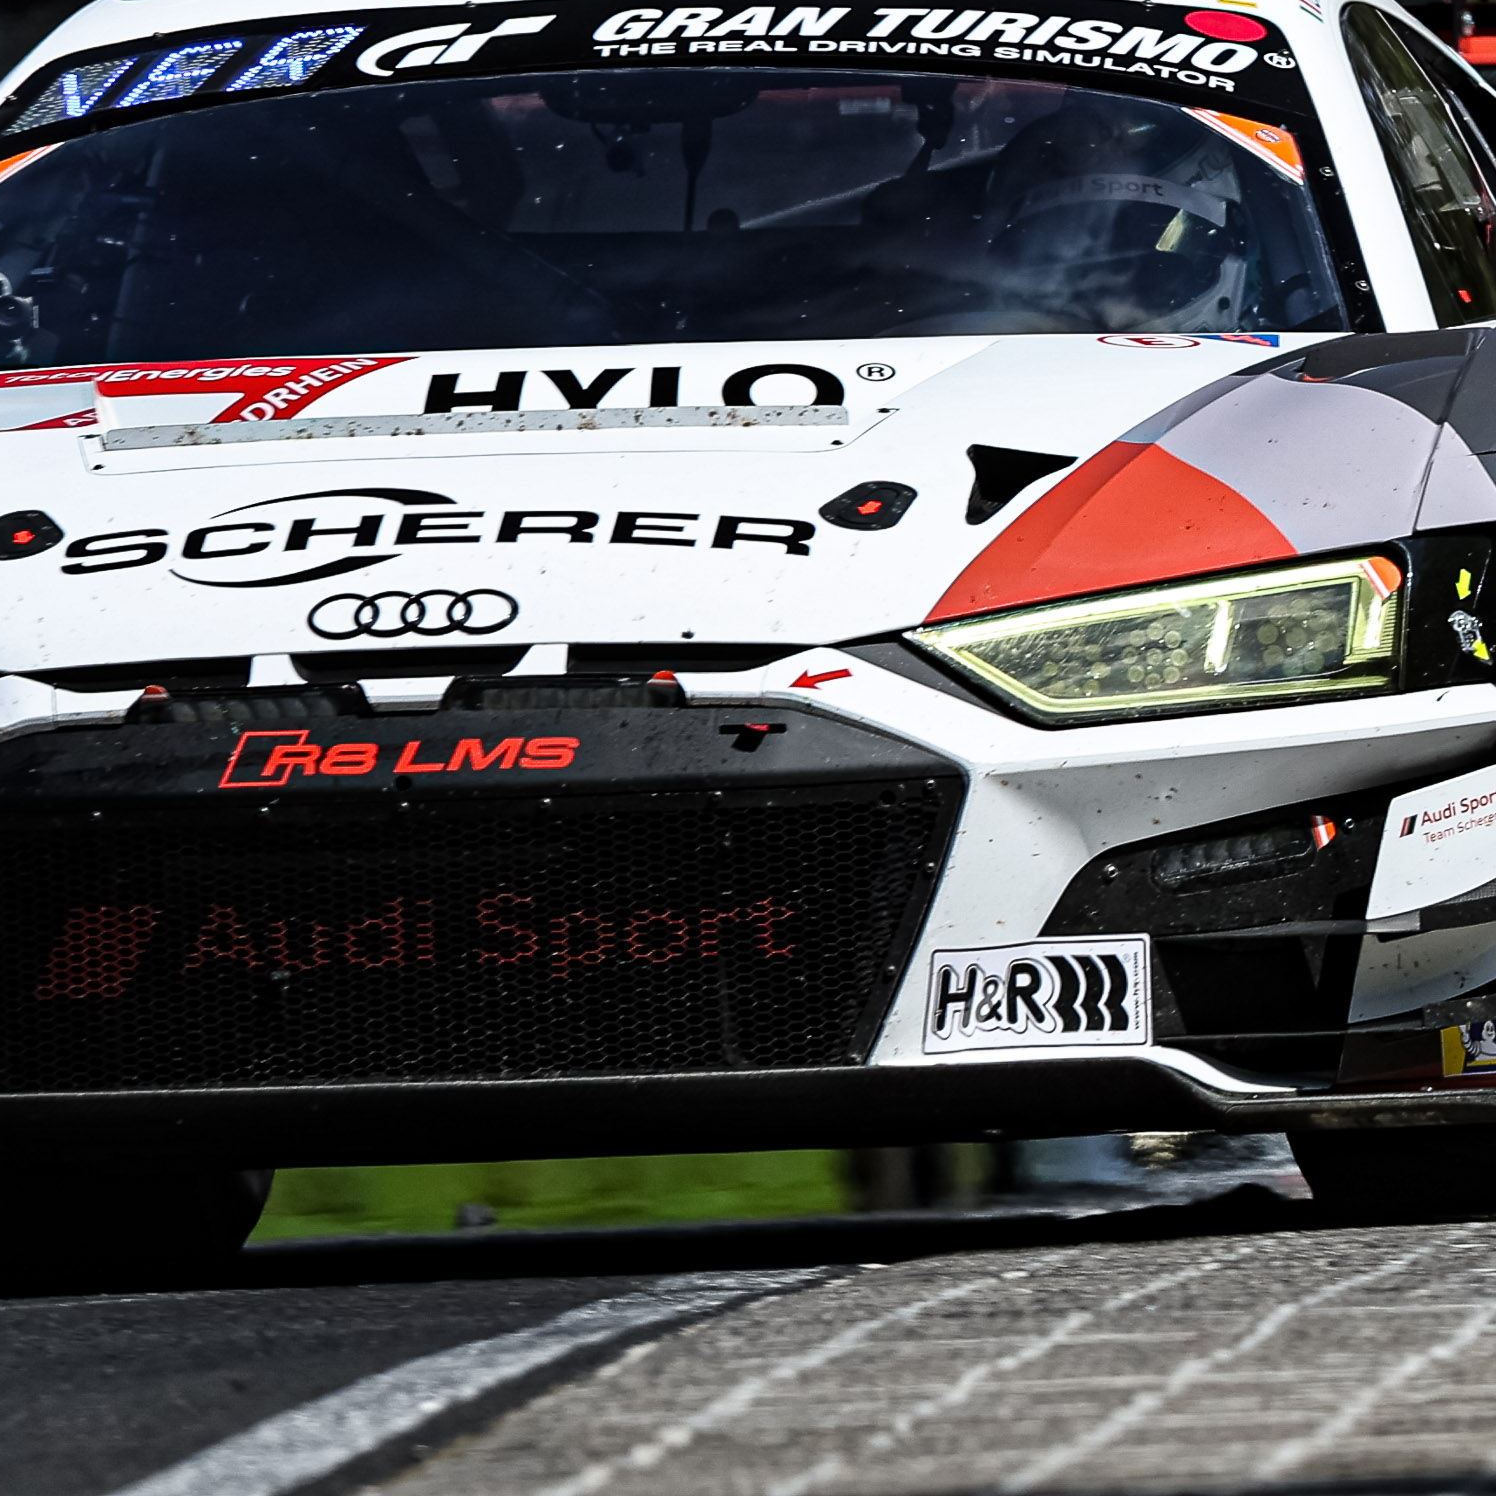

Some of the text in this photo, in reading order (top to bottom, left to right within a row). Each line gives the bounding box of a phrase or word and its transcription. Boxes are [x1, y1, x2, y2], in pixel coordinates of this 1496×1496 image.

[592, 6, 832, 42] GRAN
[867, 7, 1260, 73] TURISMO
[593, 38, 1236, 94] THE REAL DRIVING SIMULATOR
[234, 357, 380, 422] DRHEIN
[59, 508, 818, 577] SCHERER
[392, 735, 581, 775] LMS
[1421, 801, 1457, 827] Audi
[1422, 826, 1456, 844] Team
[184, 891, 797, 981] Audi Sport
[934, 958, 1056, 1041] H&R
